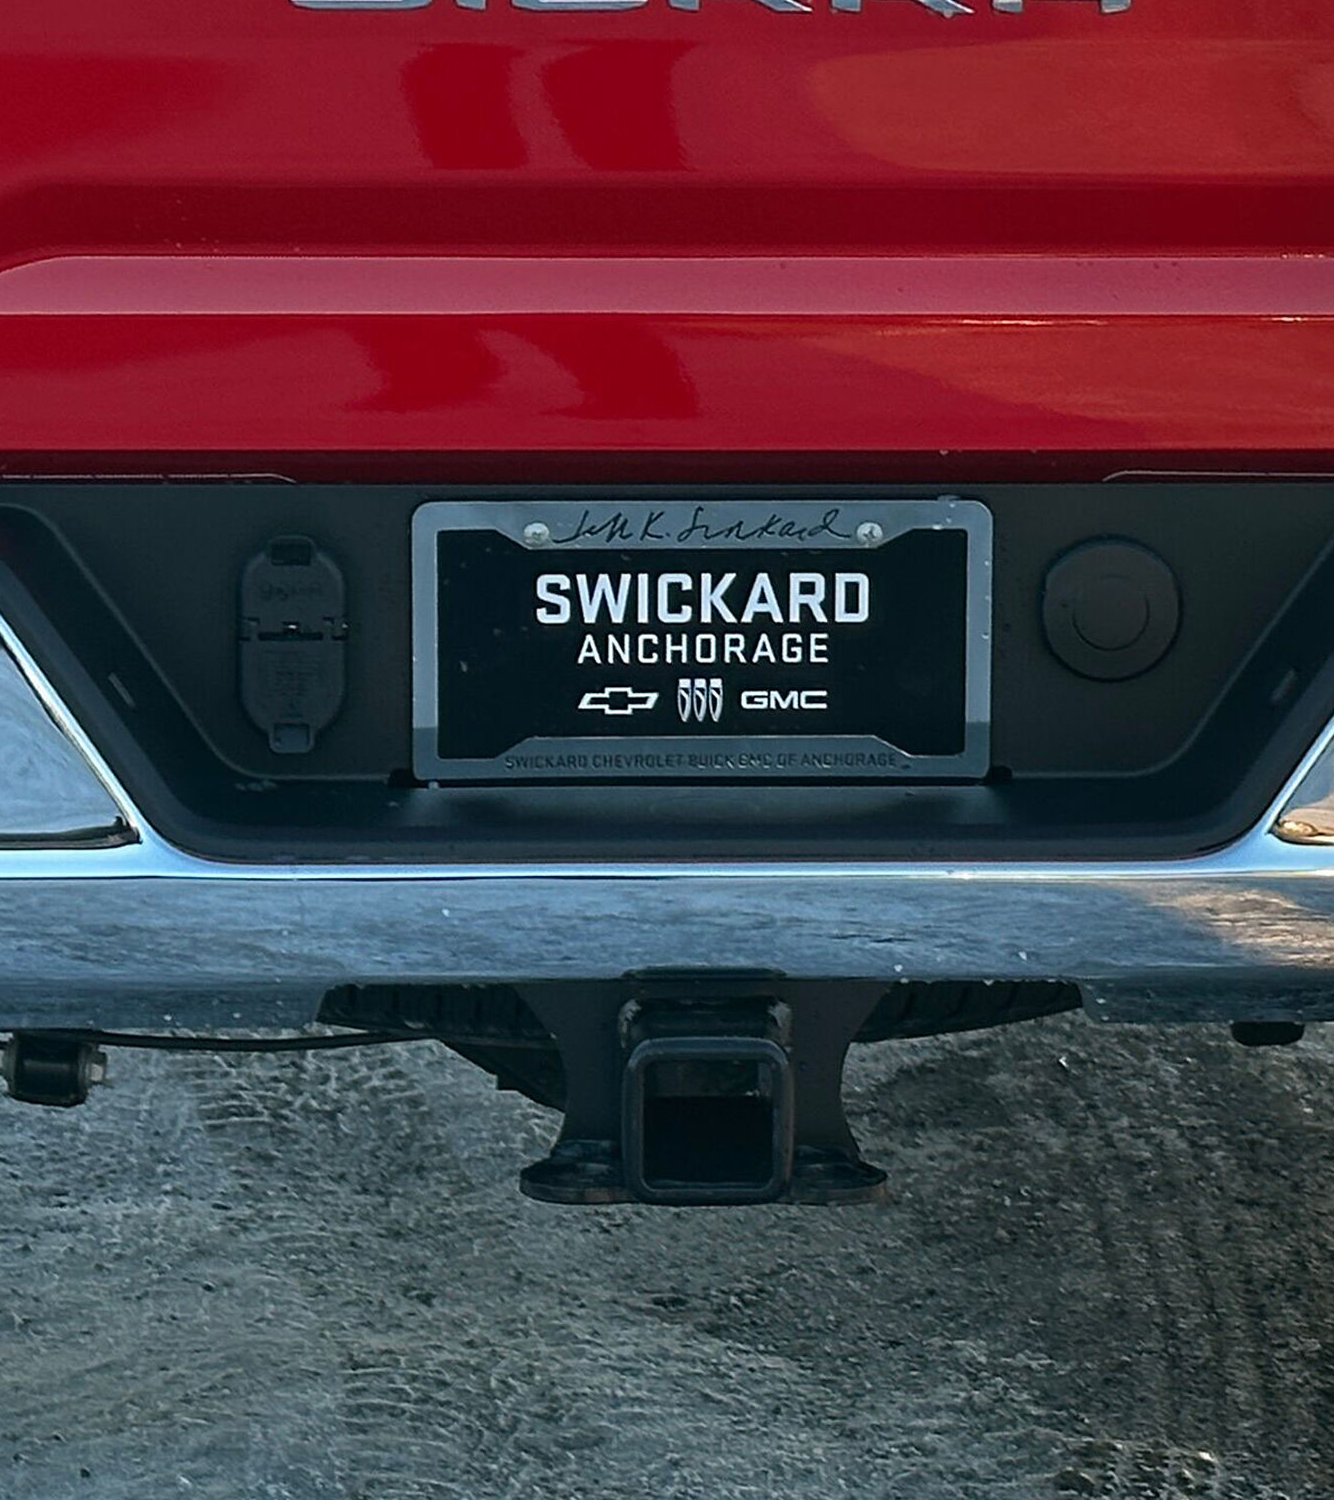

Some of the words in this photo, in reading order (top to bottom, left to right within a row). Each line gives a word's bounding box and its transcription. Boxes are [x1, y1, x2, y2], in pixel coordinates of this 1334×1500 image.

[535, 572, 870, 624] SWICKARD
[578, 634, 829, 664] ANCHORAGE
[740, 690, 828, 710] GMC
[505, 754, 588, 770] SWICKARD
[591, 754, 684, 770] CHEVROLET
[688, 753, 735, 769] BUICK
[738, 752, 772, 769] GMC
[776, 752, 796, 769] OF
[800, 752, 898, 769] ANCHORAGE
